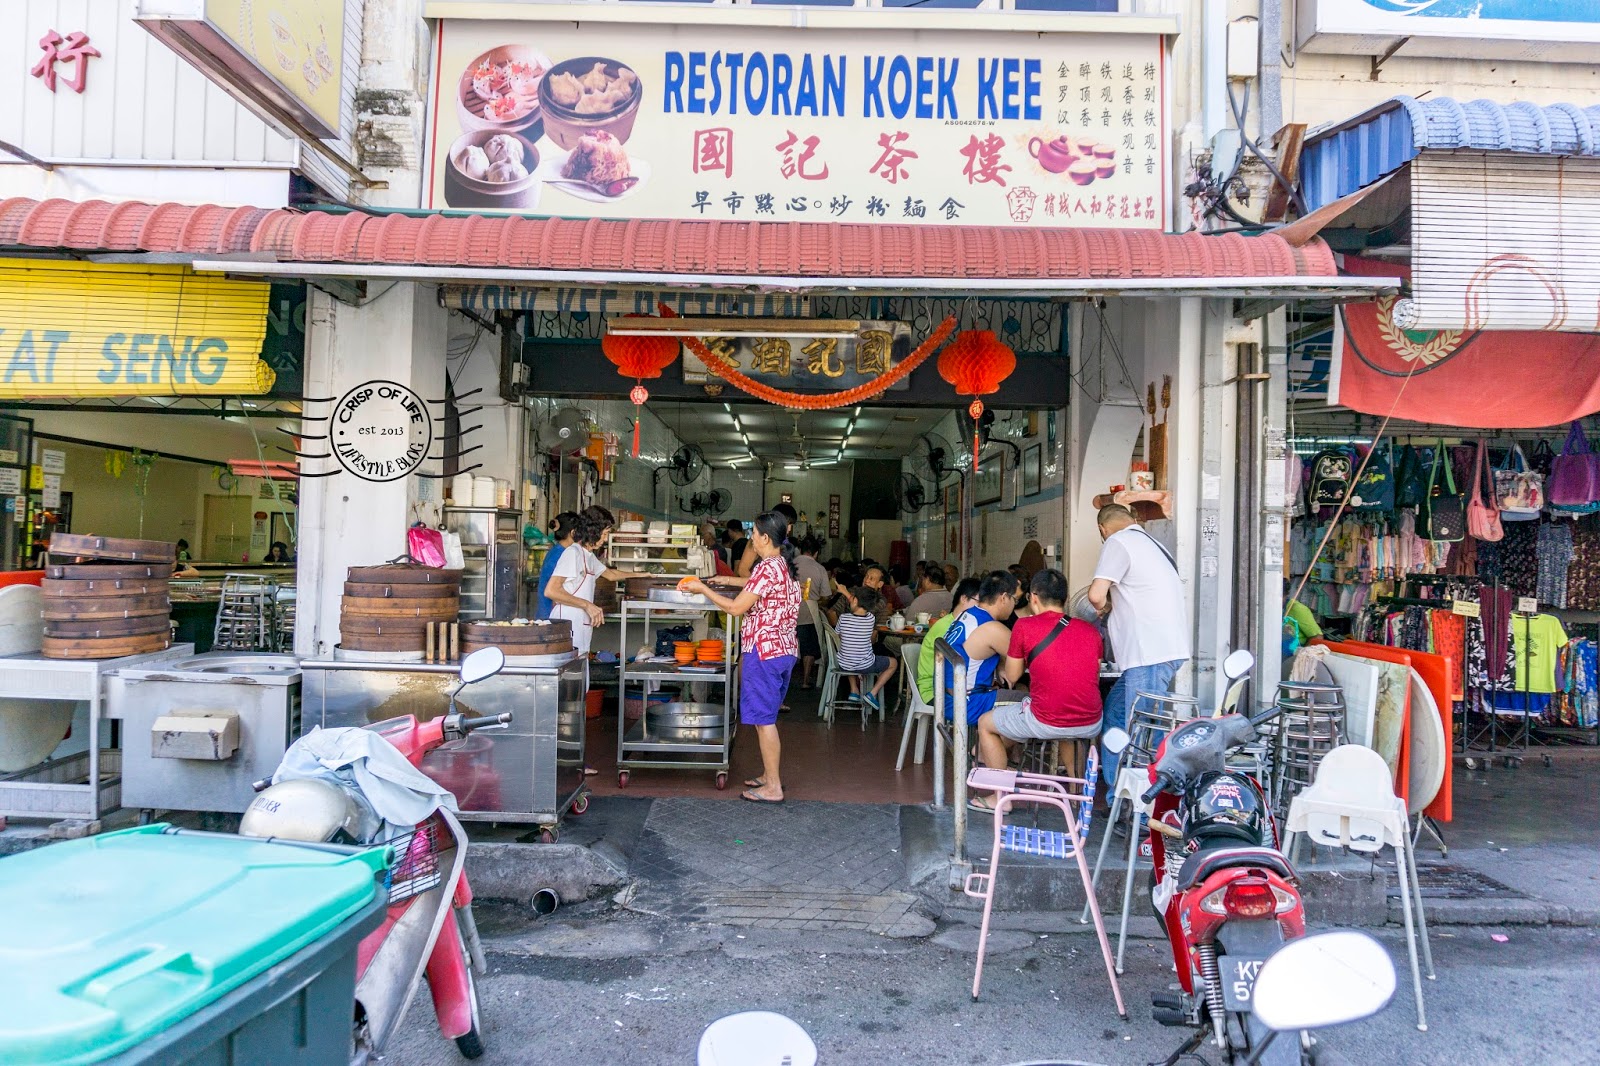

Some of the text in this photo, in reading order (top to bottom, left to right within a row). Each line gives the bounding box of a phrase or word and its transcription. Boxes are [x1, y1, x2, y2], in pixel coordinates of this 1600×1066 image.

[30, 28, 102, 94] 行
[663, 50, 1042, 121] RESTORAN KOEK KEE
[1057, 60, 1070, 125] 金罗汉
[1079, 61, 1092, 127] 醉顶香
[1100, 60, 1113, 127] 铁观音
[1122, 62, 1135, 175] 追香铁观音
[1143, 62, 1157, 175] 特别铁观音
[692, 127, 1013, 188] 國記茶樓
[0, 328, 230, 386] AT SENG
